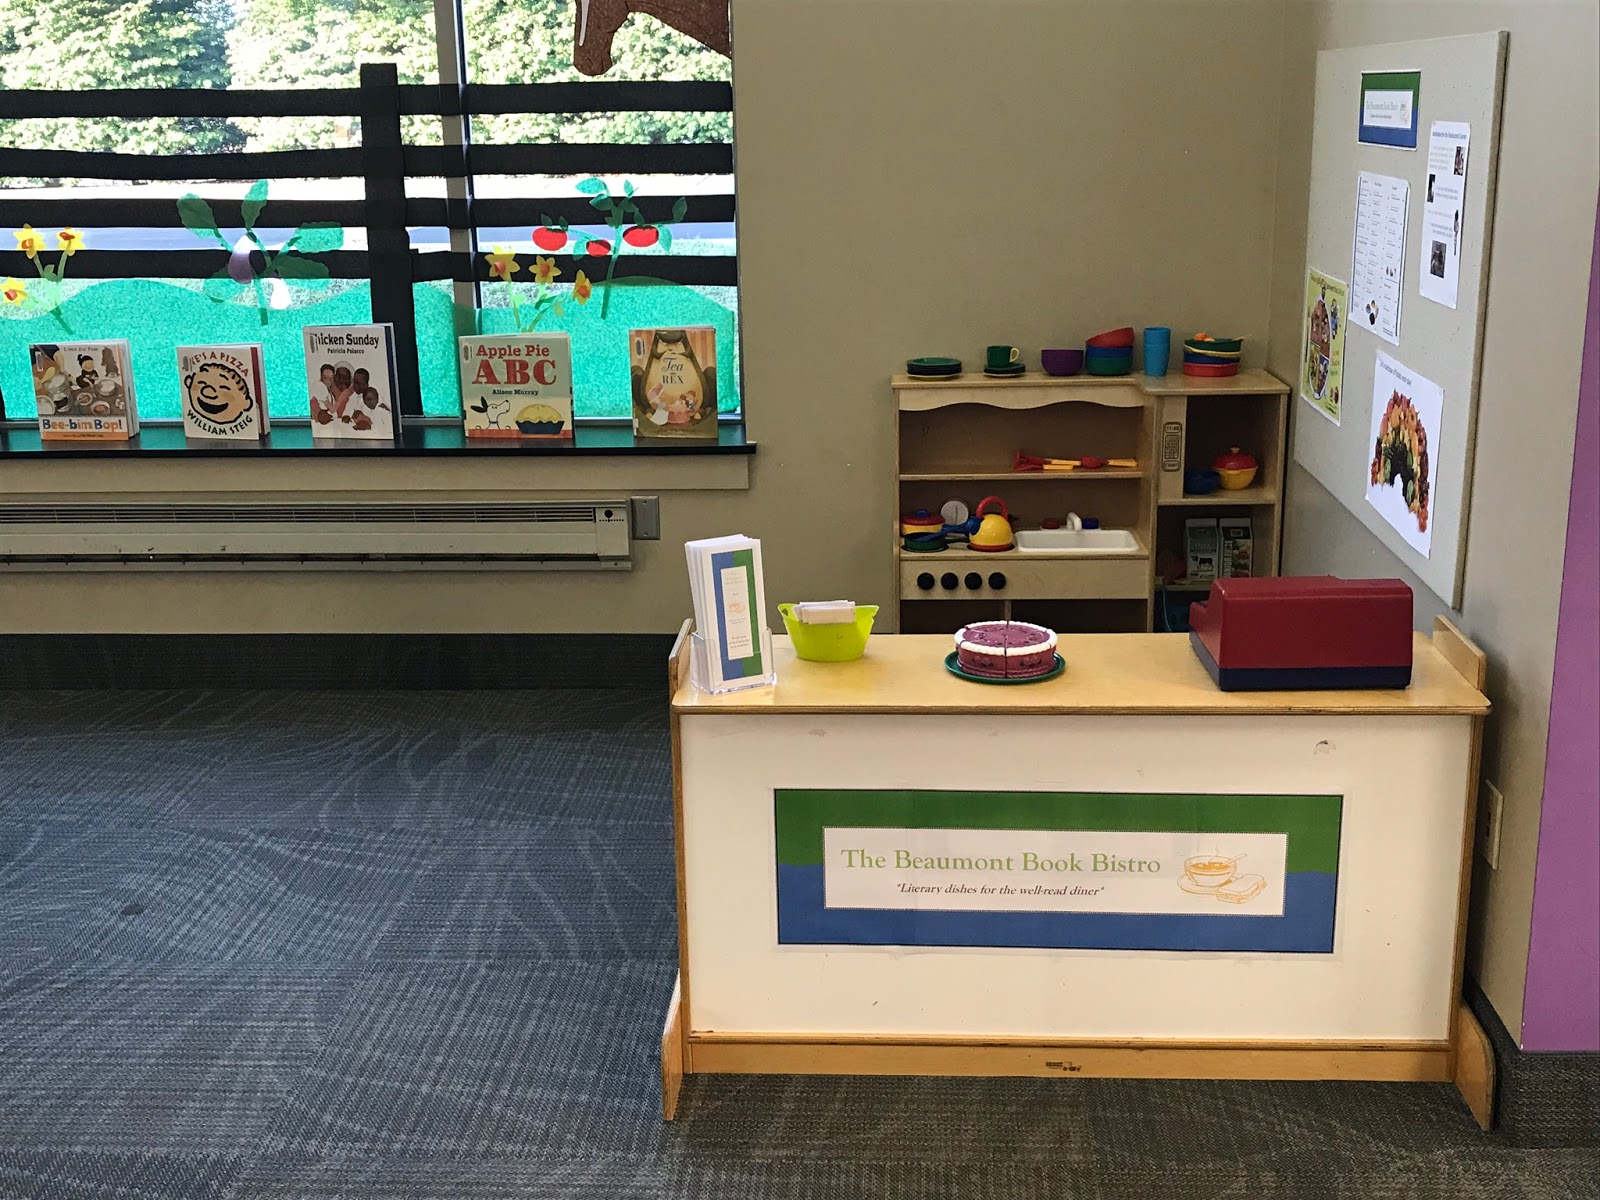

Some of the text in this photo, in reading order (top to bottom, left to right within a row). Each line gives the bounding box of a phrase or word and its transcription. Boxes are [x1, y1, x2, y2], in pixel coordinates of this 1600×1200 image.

[310, 333, 380, 349] icken Sunday
[475, 344, 550, 359] Apple Pie
[210, 351, 217, 359] A
[220, 352, 249, 377] PIZZA
[661, 357, 683, 372] Tea
[472, 359, 557, 386] ABC
[662, 375, 684, 384] REX
[514, 389, 539, 397] Murray
[42, 419, 122, 432] Bee-bim Bop!
[187, 410, 253, 435] WILLIAM STEIG
[840, 848, 1161, 873] The Beaumont Book Bistro
[944, 883, 977, 894] dishes
[979, 883, 997, 894] for
[998, 884, 1017, 895] the
[1019, 884, 1067, 896] well-read
